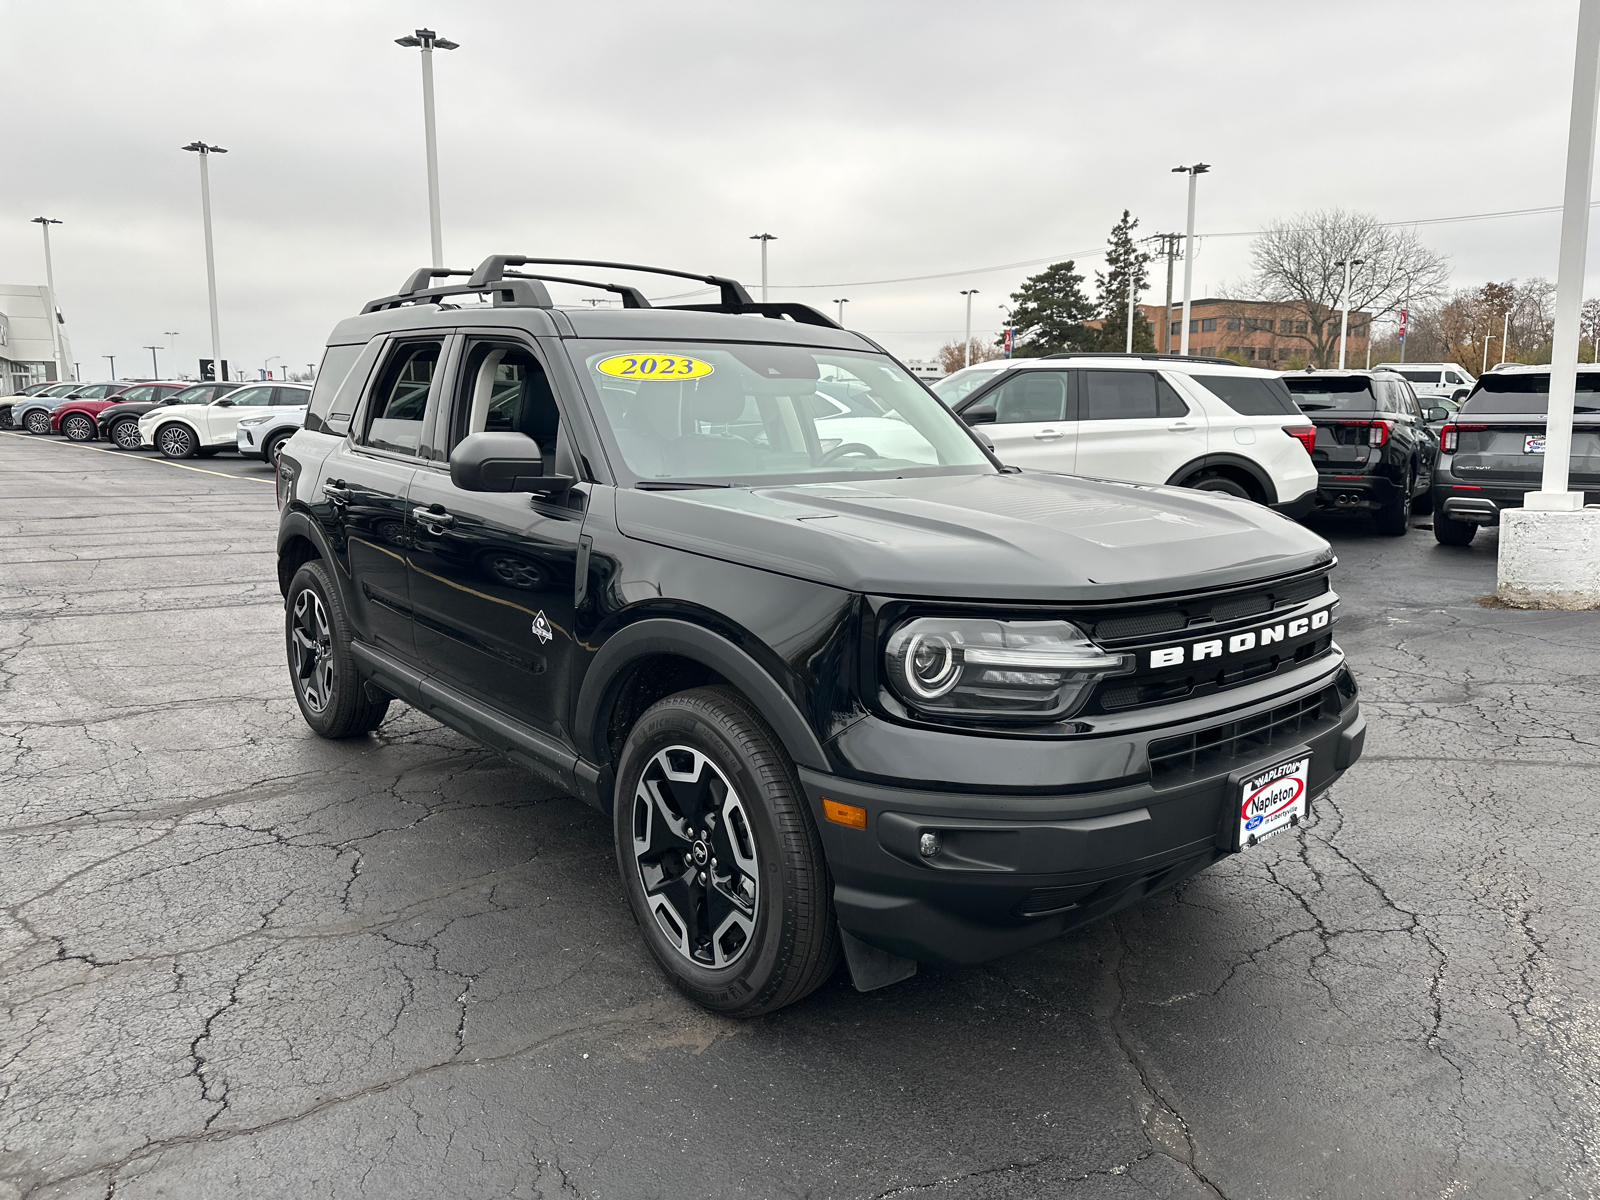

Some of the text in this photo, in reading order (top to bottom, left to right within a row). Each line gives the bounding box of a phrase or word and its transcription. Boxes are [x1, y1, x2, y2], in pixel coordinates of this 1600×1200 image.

[620, 358, 694, 375] 2023
[1150, 610, 1329, 669] BRONCO
[648, 717, 696, 732] MICHELIN
[700, 728, 724, 751] 225/60
[730, 759, 738, 768] 18
[1251, 786, 1294, 815] Napleton
[1247, 816, 1262, 830] Ford
[1271, 806, 1298, 822] Libertyville
[1257, 822, 1292, 844] LIBERTYVILLE
